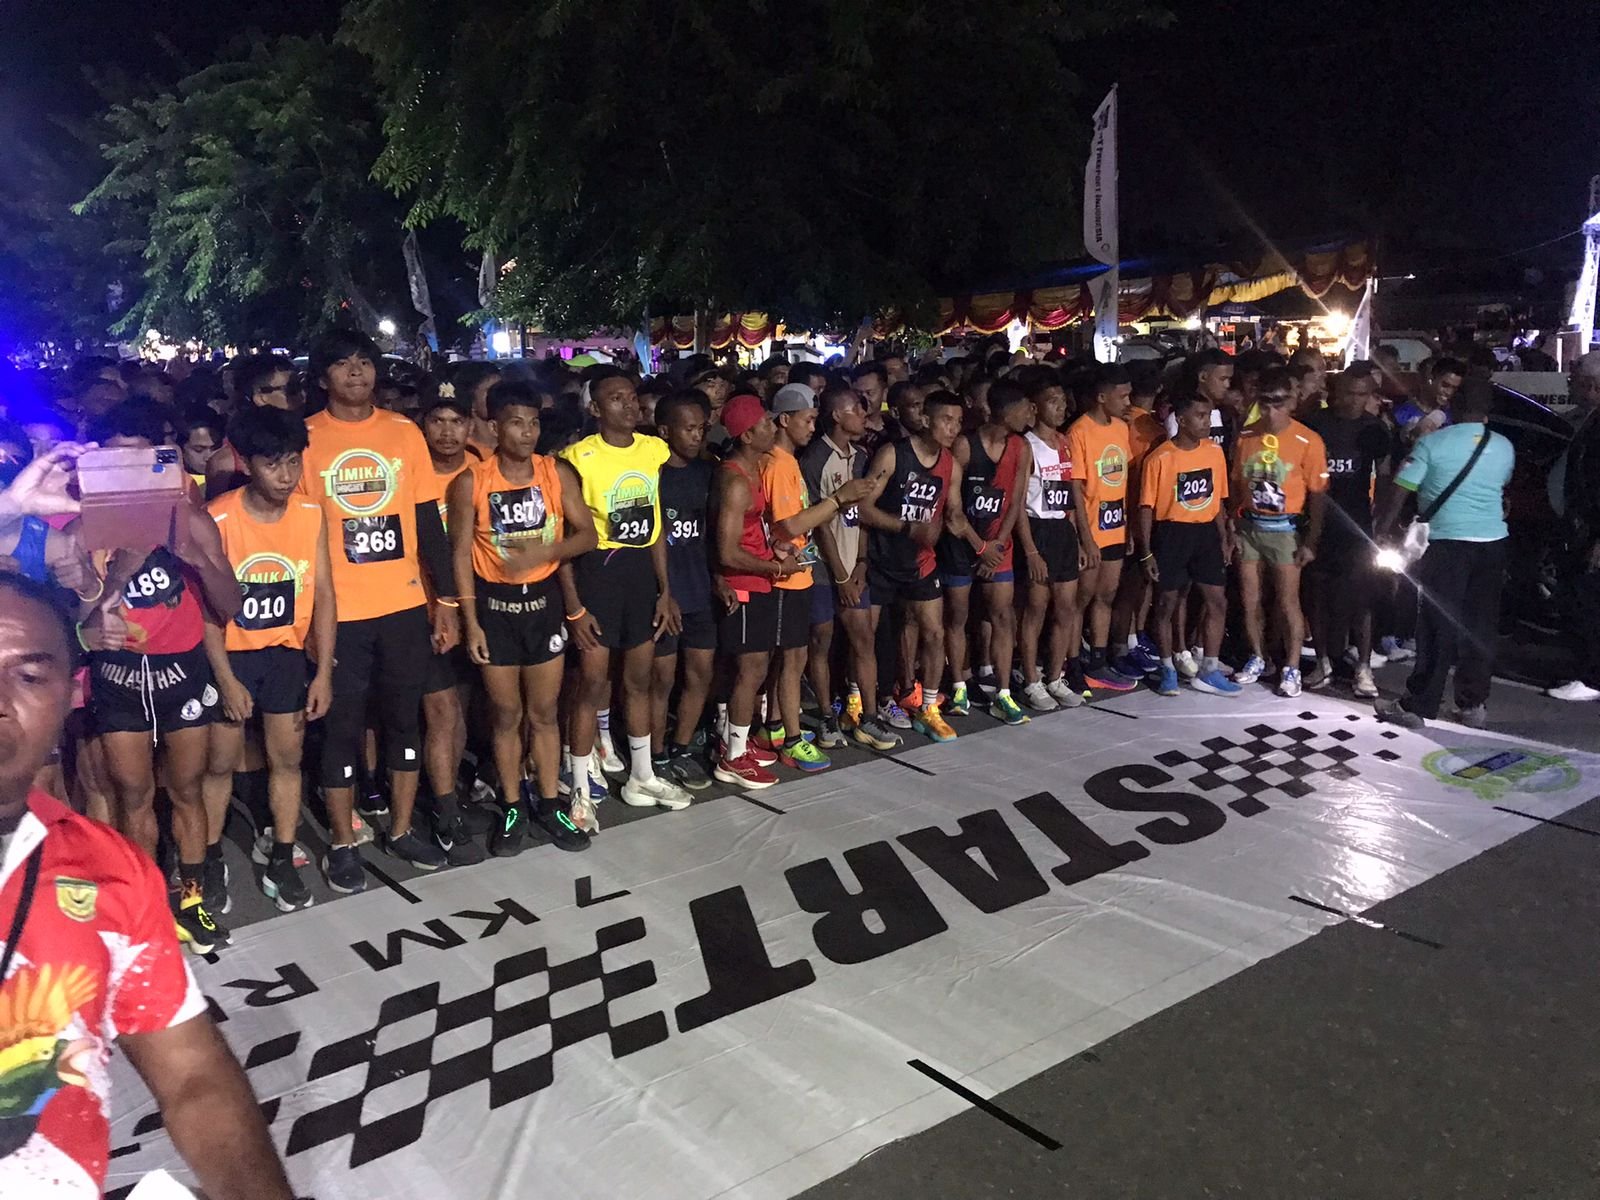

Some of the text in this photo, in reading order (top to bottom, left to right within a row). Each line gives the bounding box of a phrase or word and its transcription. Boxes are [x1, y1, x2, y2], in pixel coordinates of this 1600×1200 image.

[1328, 459, 1353, 473] 251
[320, 466, 385, 497] TIMIKA
[909, 482, 936, 500] 212
[1184, 479, 1207, 495] 202
[975, 496, 1000, 513] 041
[1047, 490, 1069, 505] 307
[500, 501, 534, 524] 187
[618, 519, 649, 540] 234
[672, 519, 699, 538] 391
[354, 530, 396, 553] 268
[126, 566, 170, 599] 189
[243, 596, 285, 619] 010
[675, 763, 1228, 1034] START
[350, 899, 540, 971] KM
